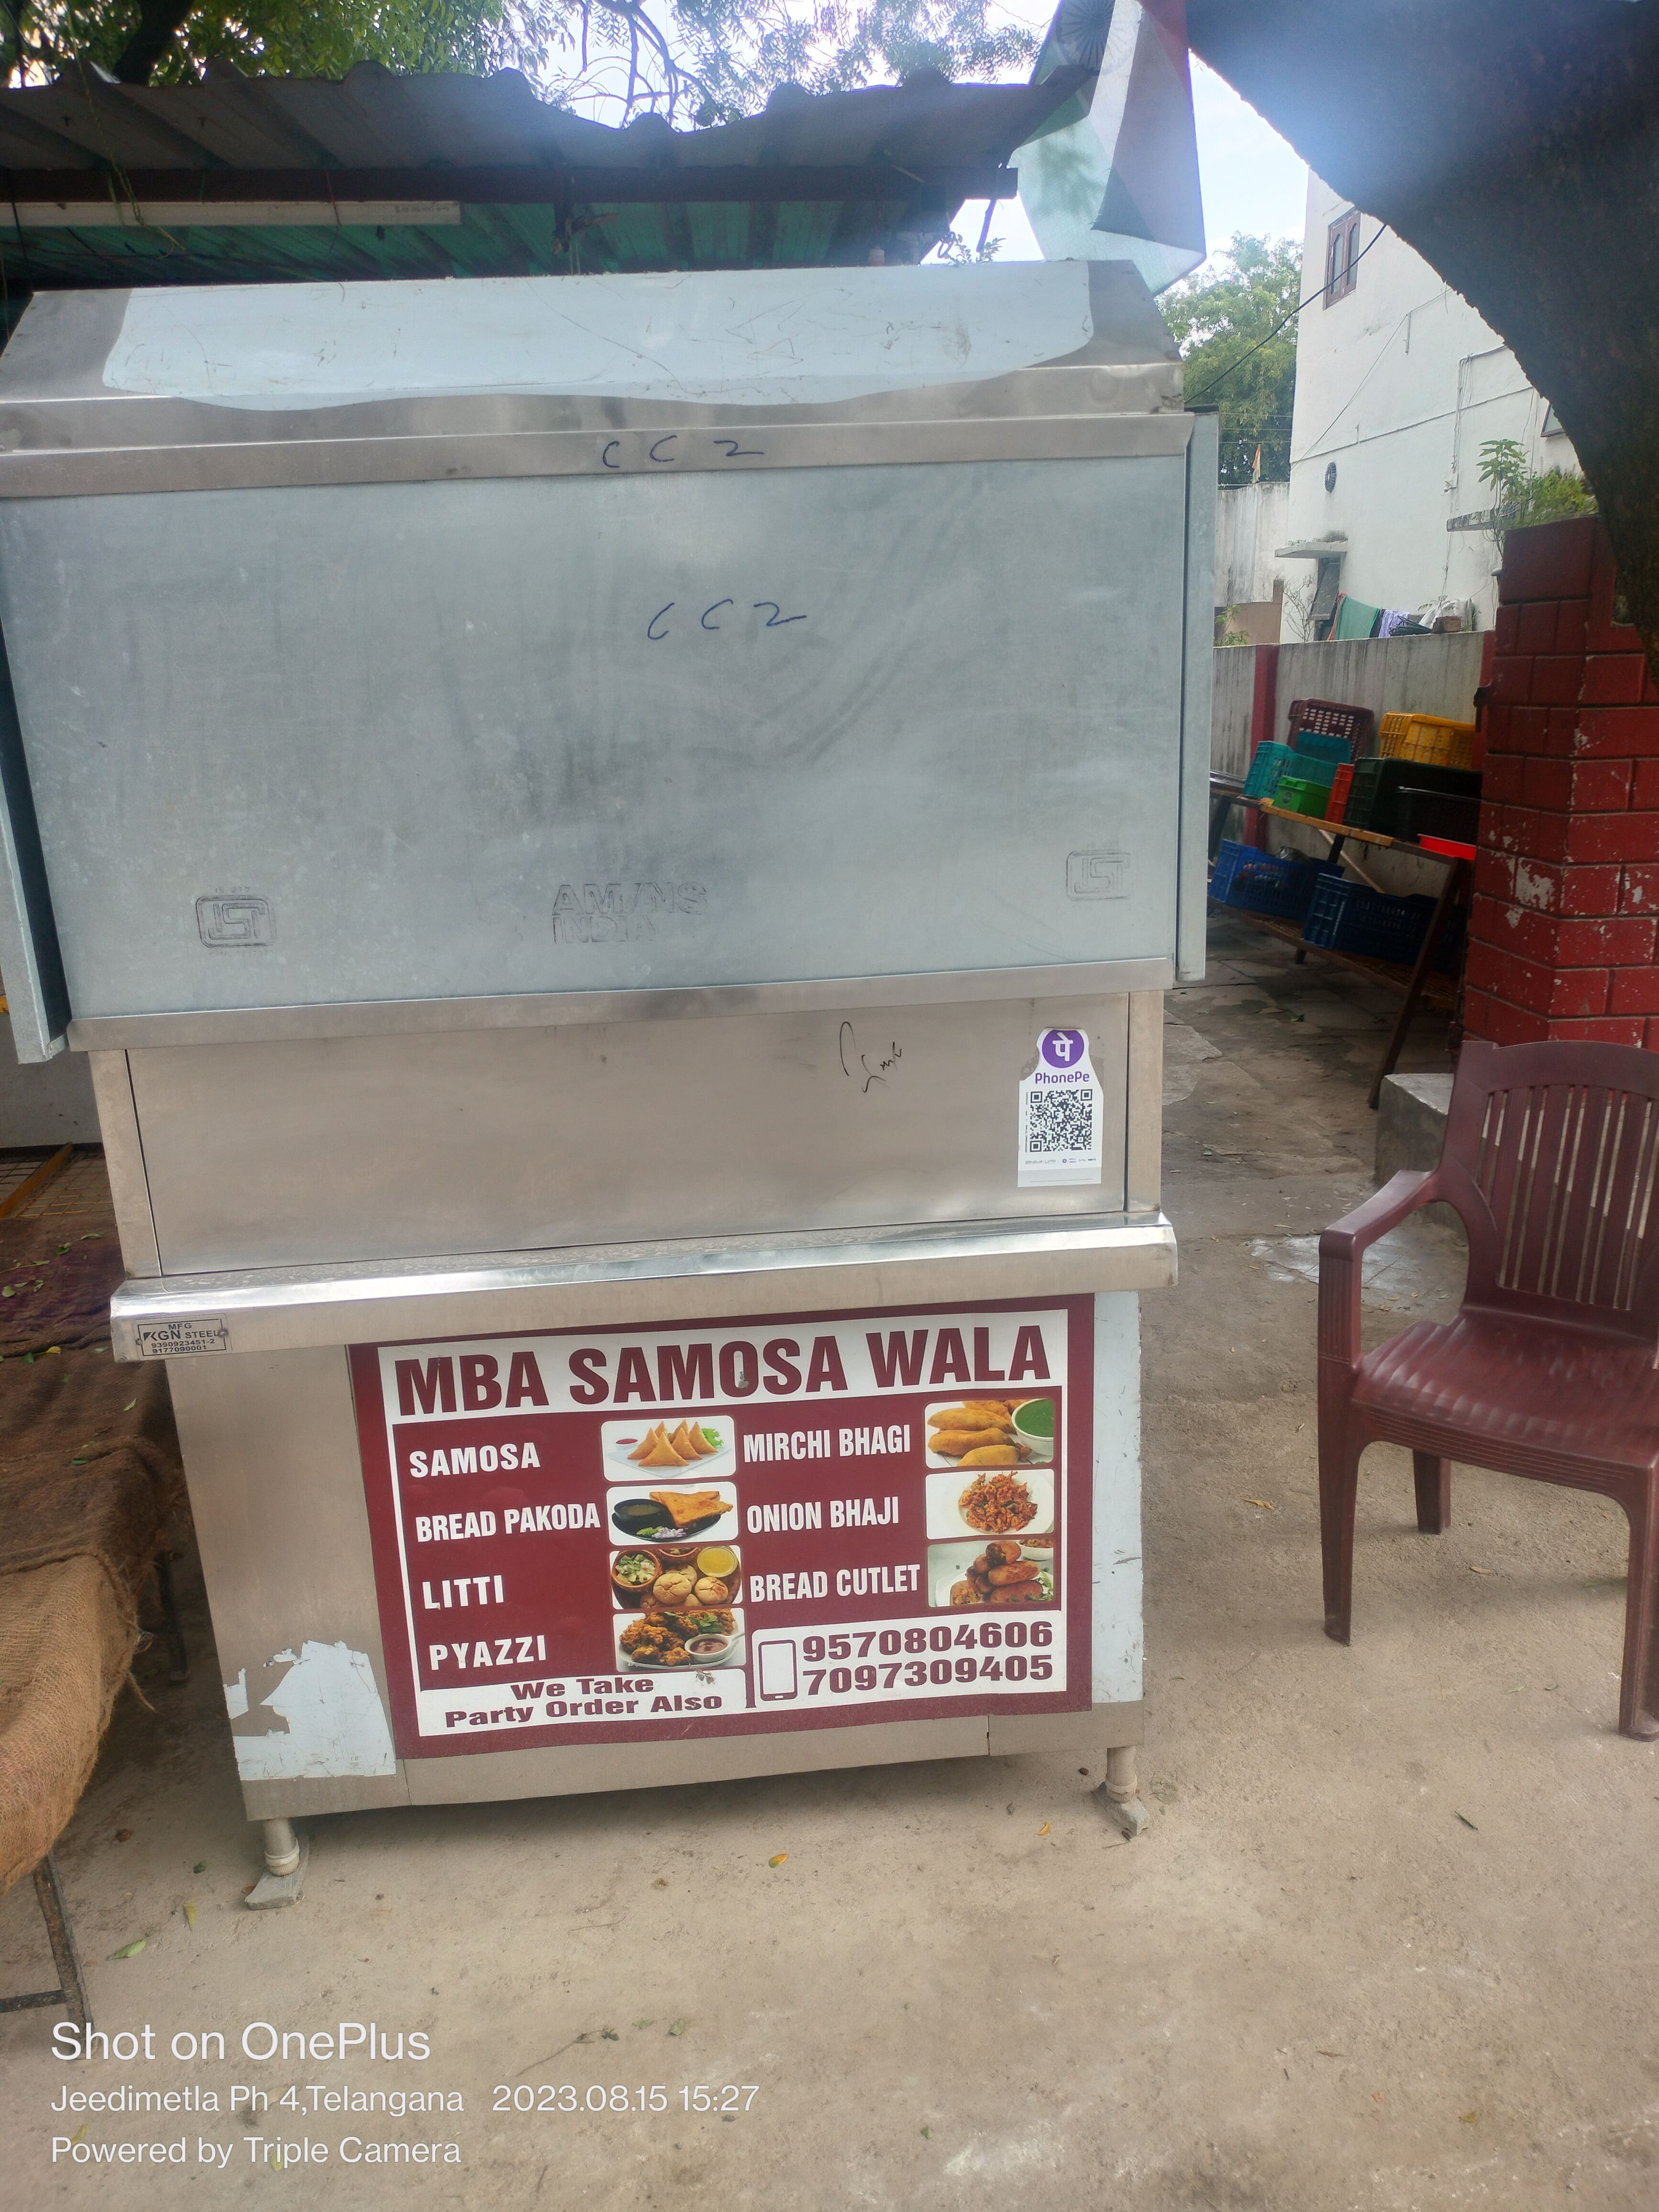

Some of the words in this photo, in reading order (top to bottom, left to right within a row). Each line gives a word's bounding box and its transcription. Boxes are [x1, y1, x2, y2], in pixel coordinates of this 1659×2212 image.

[1035, 1071, 1089, 1084] PhonePe
[144, 1330, 181, 1341] KGN
[395, 1351, 549, 1416] MBA
[568, 1335, 848, 1405] SAMOSA
[865, 1326, 1051, 1389] WALA
[410, 1442, 540, 1477] SAMOSA
[744, 1430, 830, 1462] MIRCHI
[839, 1425, 910, 1456] BHAGI
[416, 1511, 496, 1542] BREAD
[504, 1503, 600, 1534] PAKODA
[747, 1502, 821, 1533] ONION
[830, 1496, 898, 1527] BHAJI
[422, 1575, 503, 1610] LITTI
[751, 1571, 827, 1602] BREAD
[837, 1563, 920, 1594] CUTLET
[430, 1635, 546, 1670] PYAZZI
[803, 1621, 1052, 1662] 9570804606
[511, 1680, 565, 1701] We
[575, 1677, 654, 1695] Take
[803, 1654, 1053, 1696] 7097309405
[445, 1707, 534, 1728] Party
[546, 1698, 640, 1718] Order
[651, 1695, 721, 1712] Also
